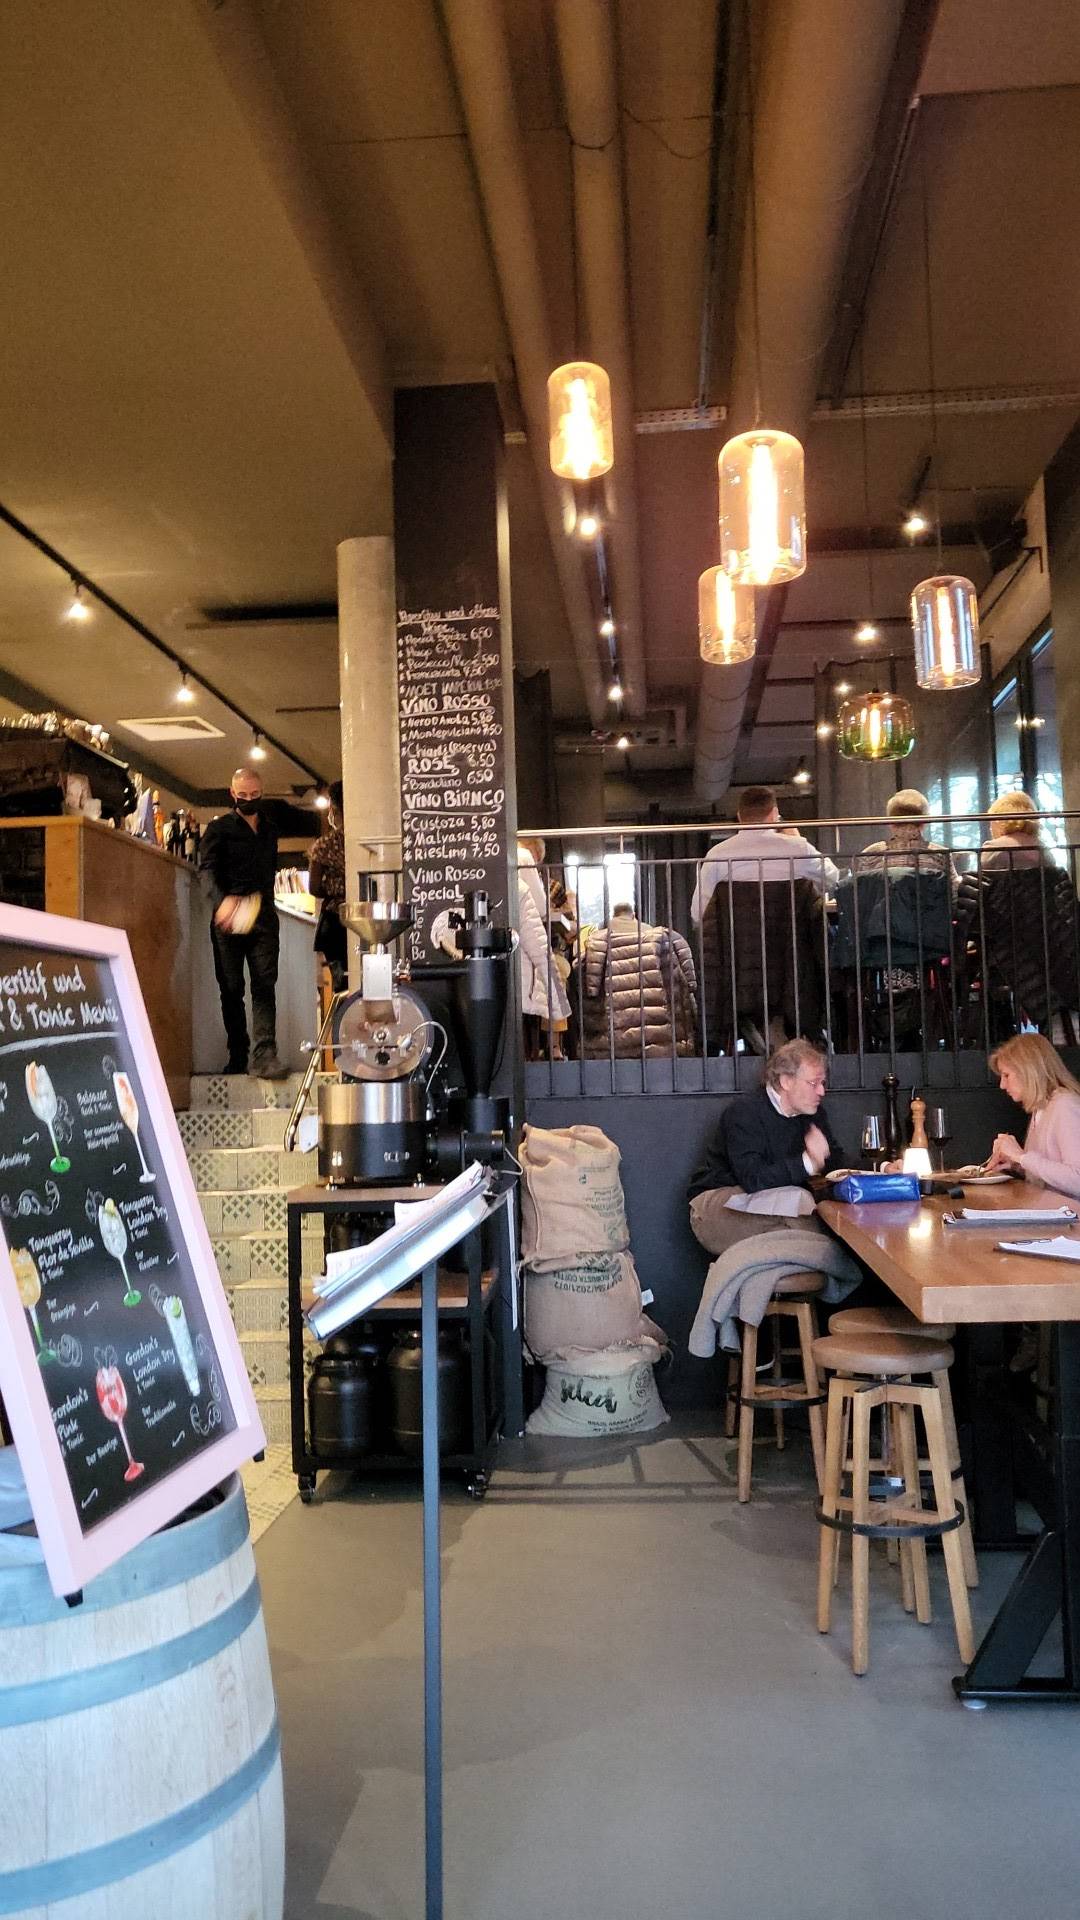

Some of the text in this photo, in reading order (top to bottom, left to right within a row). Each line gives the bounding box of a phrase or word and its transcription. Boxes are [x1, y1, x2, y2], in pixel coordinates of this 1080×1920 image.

[0, 962, 86, 1001] eritif und
[26, 1002, 76, 1030] Tonic
